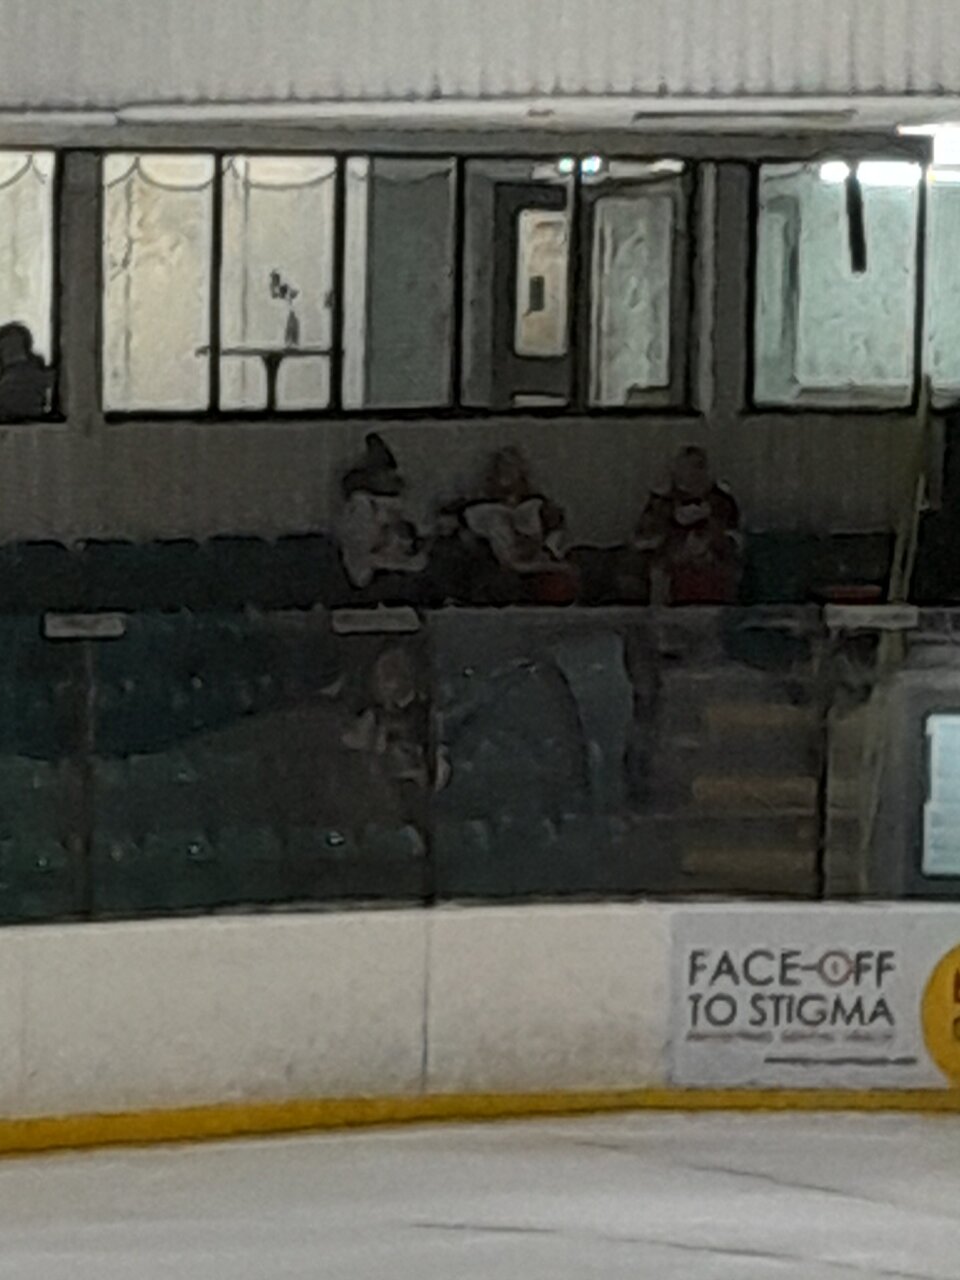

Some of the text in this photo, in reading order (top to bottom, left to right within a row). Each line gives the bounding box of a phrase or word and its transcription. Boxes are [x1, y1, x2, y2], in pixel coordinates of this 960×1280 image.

[689, 950, 896, 987] FACE-OFF
[688, 993, 895, 1026] TO STIGMA
